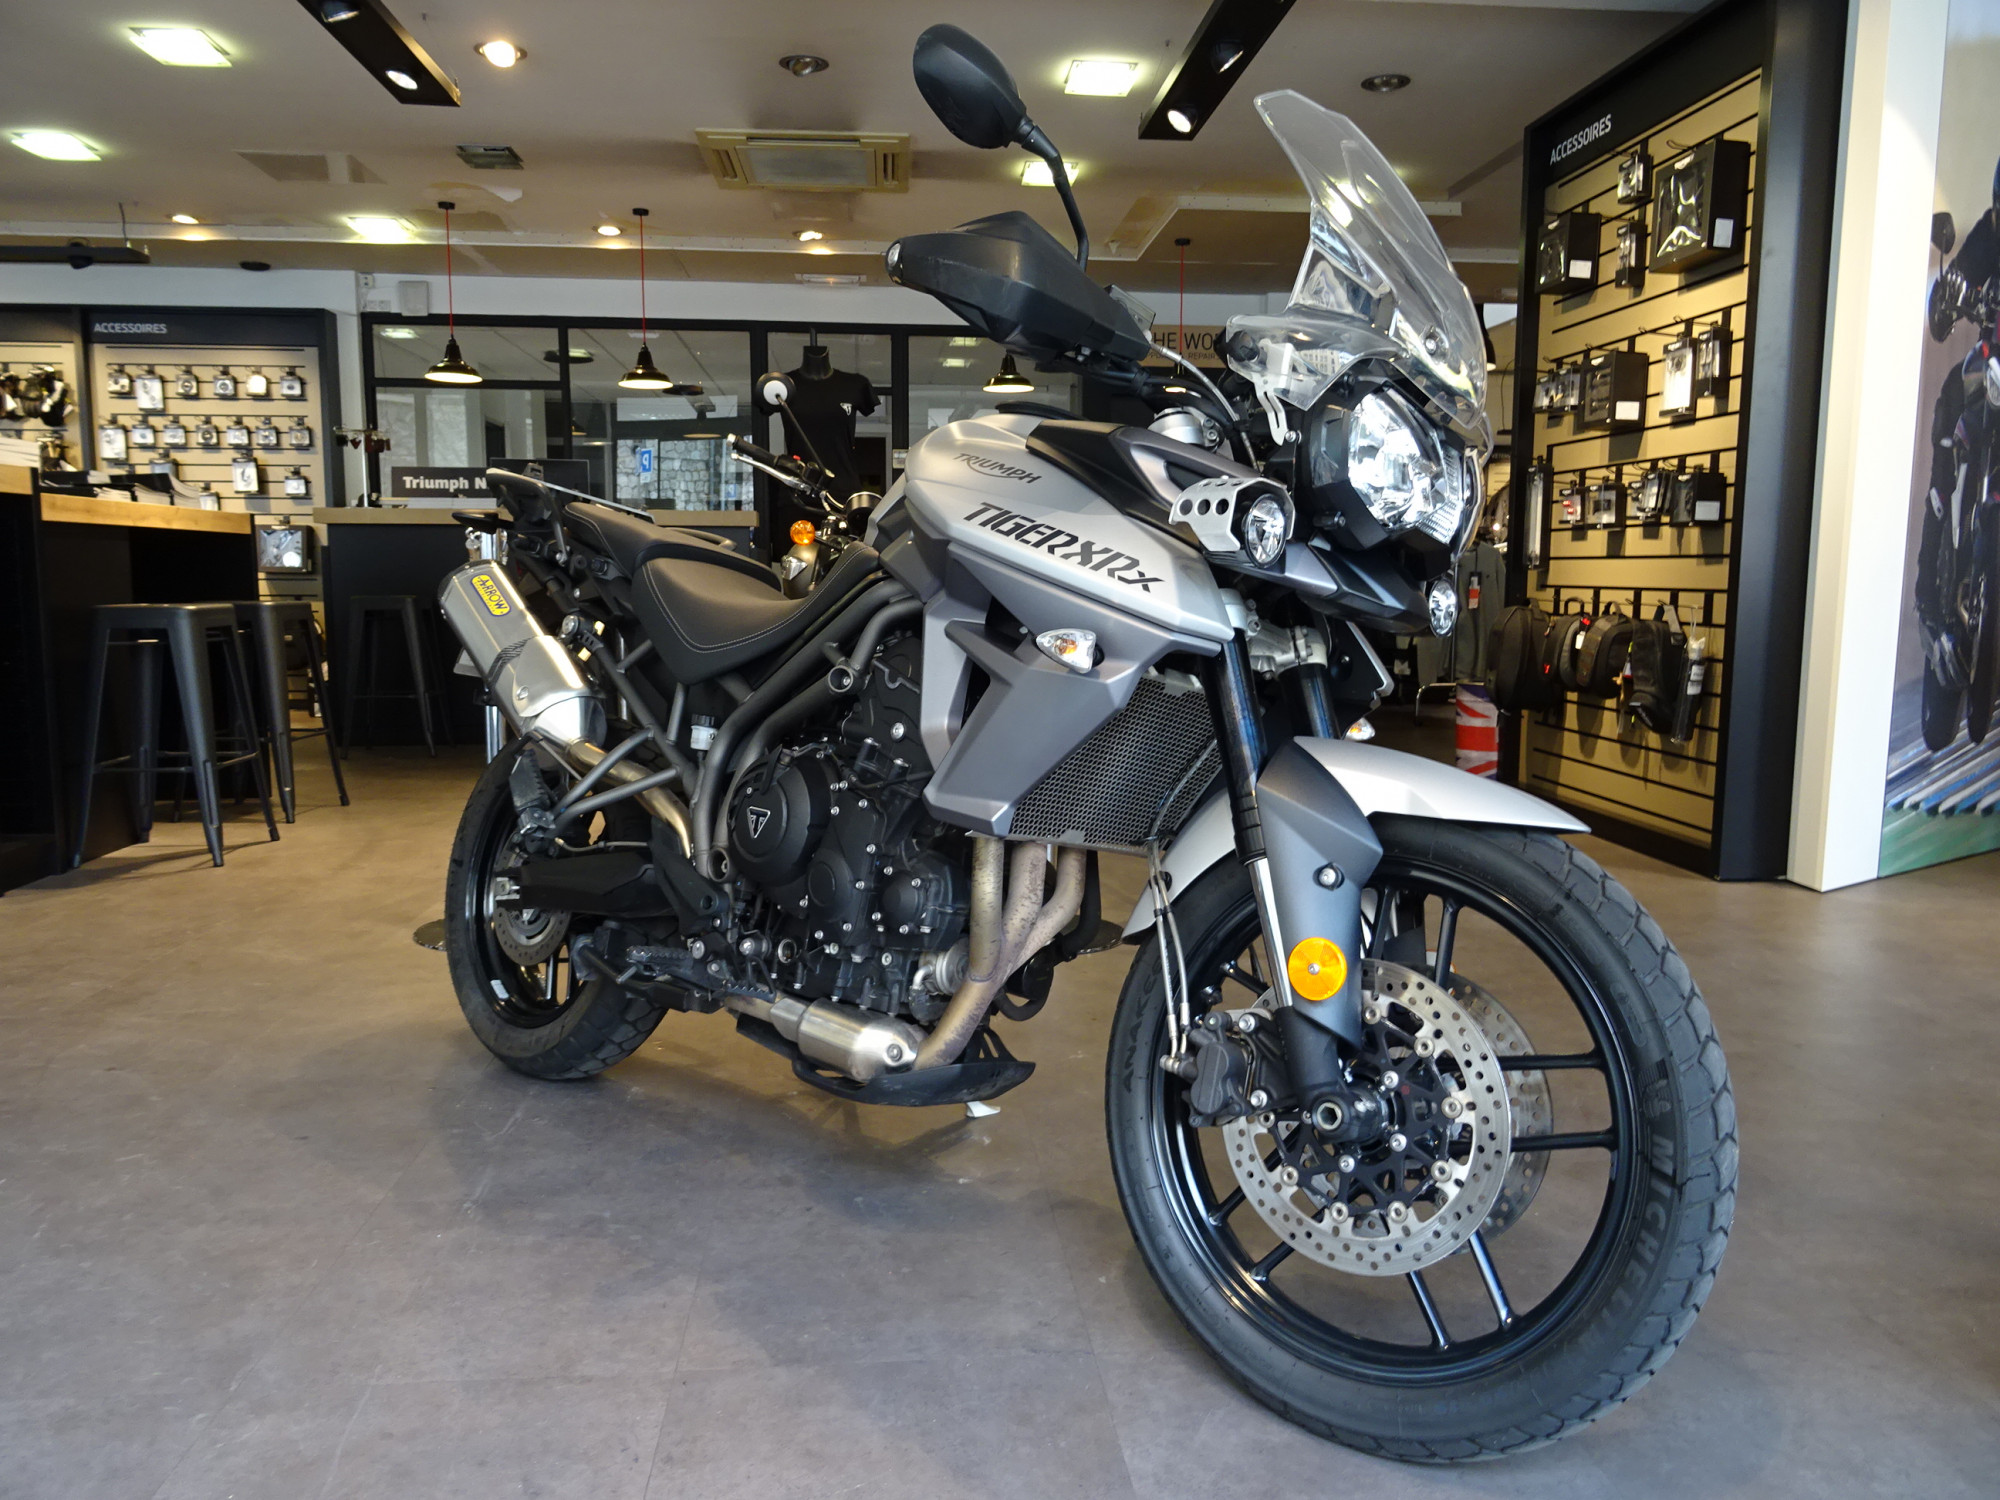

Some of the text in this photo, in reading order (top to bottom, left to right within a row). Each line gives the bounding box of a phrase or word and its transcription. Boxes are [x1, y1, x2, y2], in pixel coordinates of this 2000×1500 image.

[1550, 113, 1612, 166] ACCESSOIRES
[94, 322, 167, 334] ACCESSOIRES
[953, 453, 1042, 484] TRIUMPH
[402, 476, 469, 492] Triumph
[477, 579, 508, 609] ARROW
[1578, 1134, 1676, 1356] MICHELIN
